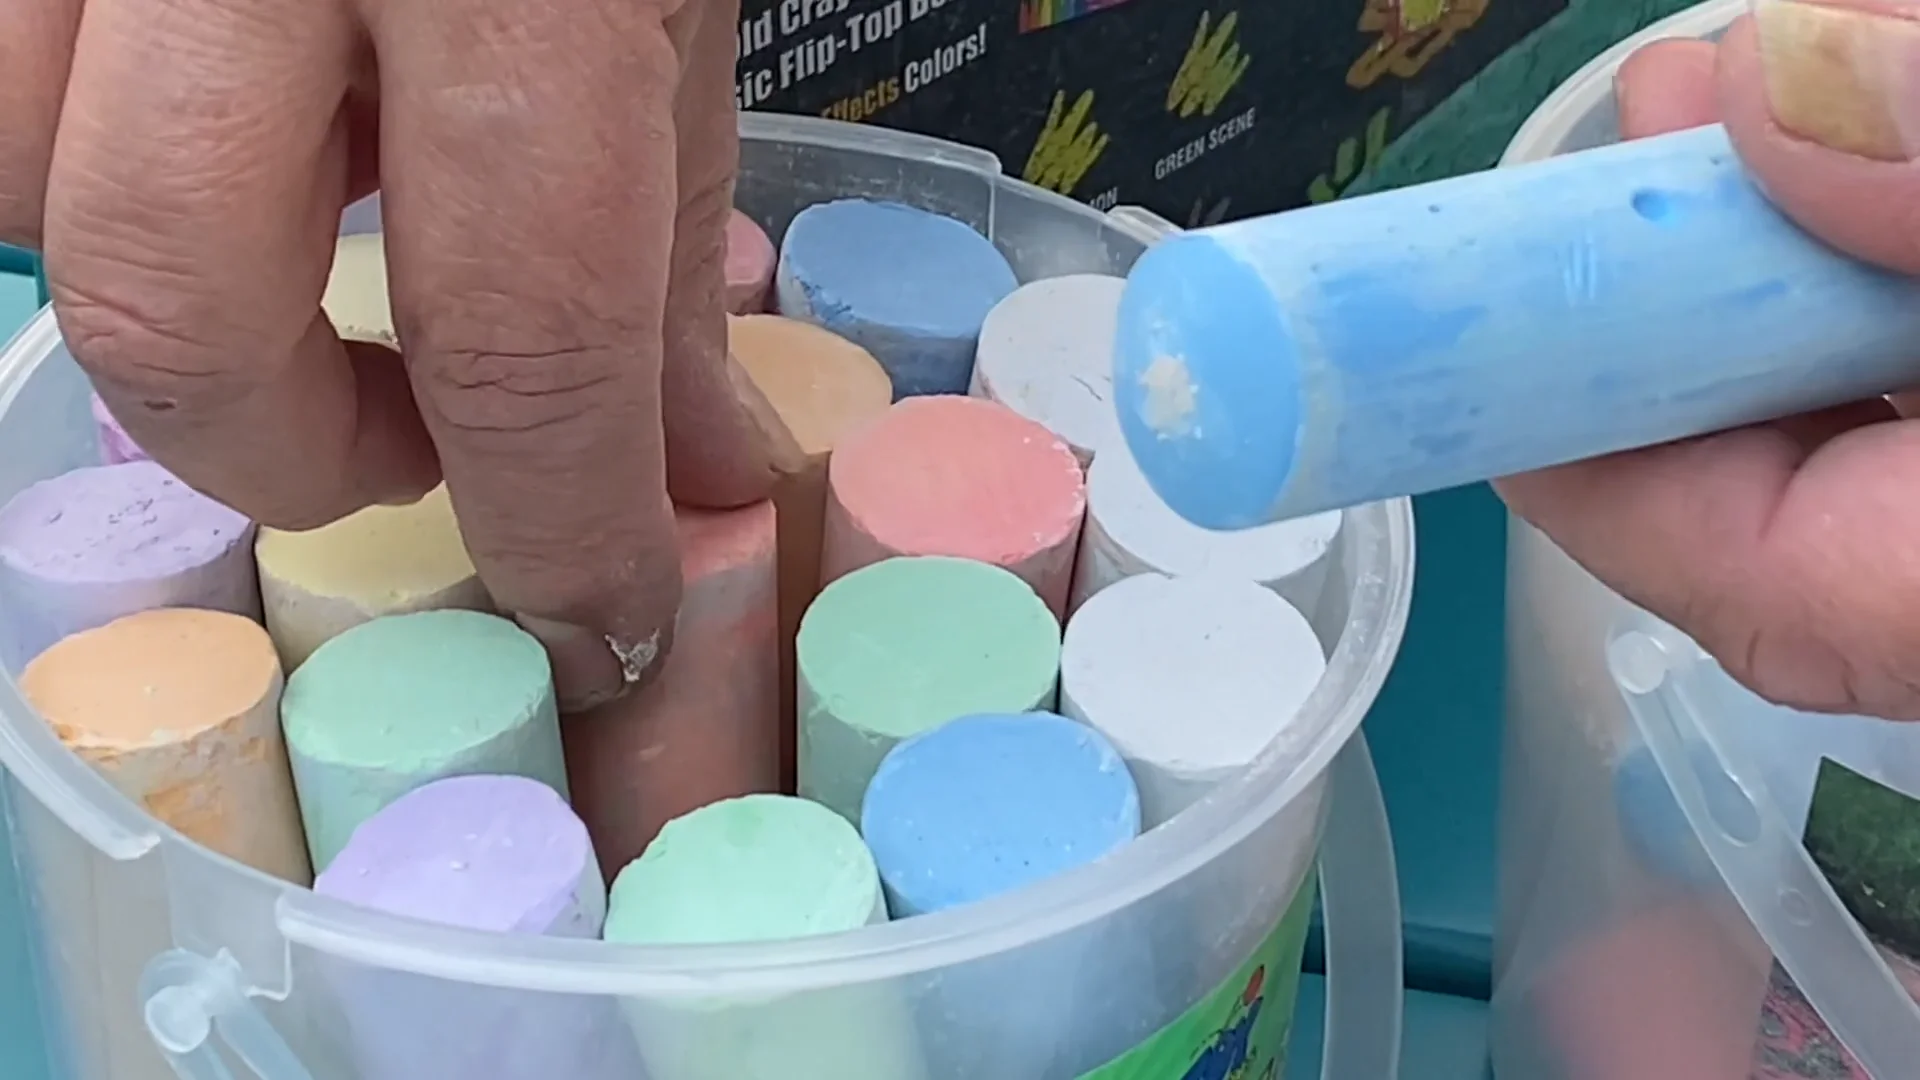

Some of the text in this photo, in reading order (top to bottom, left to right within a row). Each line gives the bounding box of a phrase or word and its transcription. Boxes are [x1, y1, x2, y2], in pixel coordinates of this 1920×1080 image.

[780, 1, 903, 90] Flip-Top
[904, 22, 987, 93] Colors!
[1155, 107, 1256, 180] GREEN SCENE
